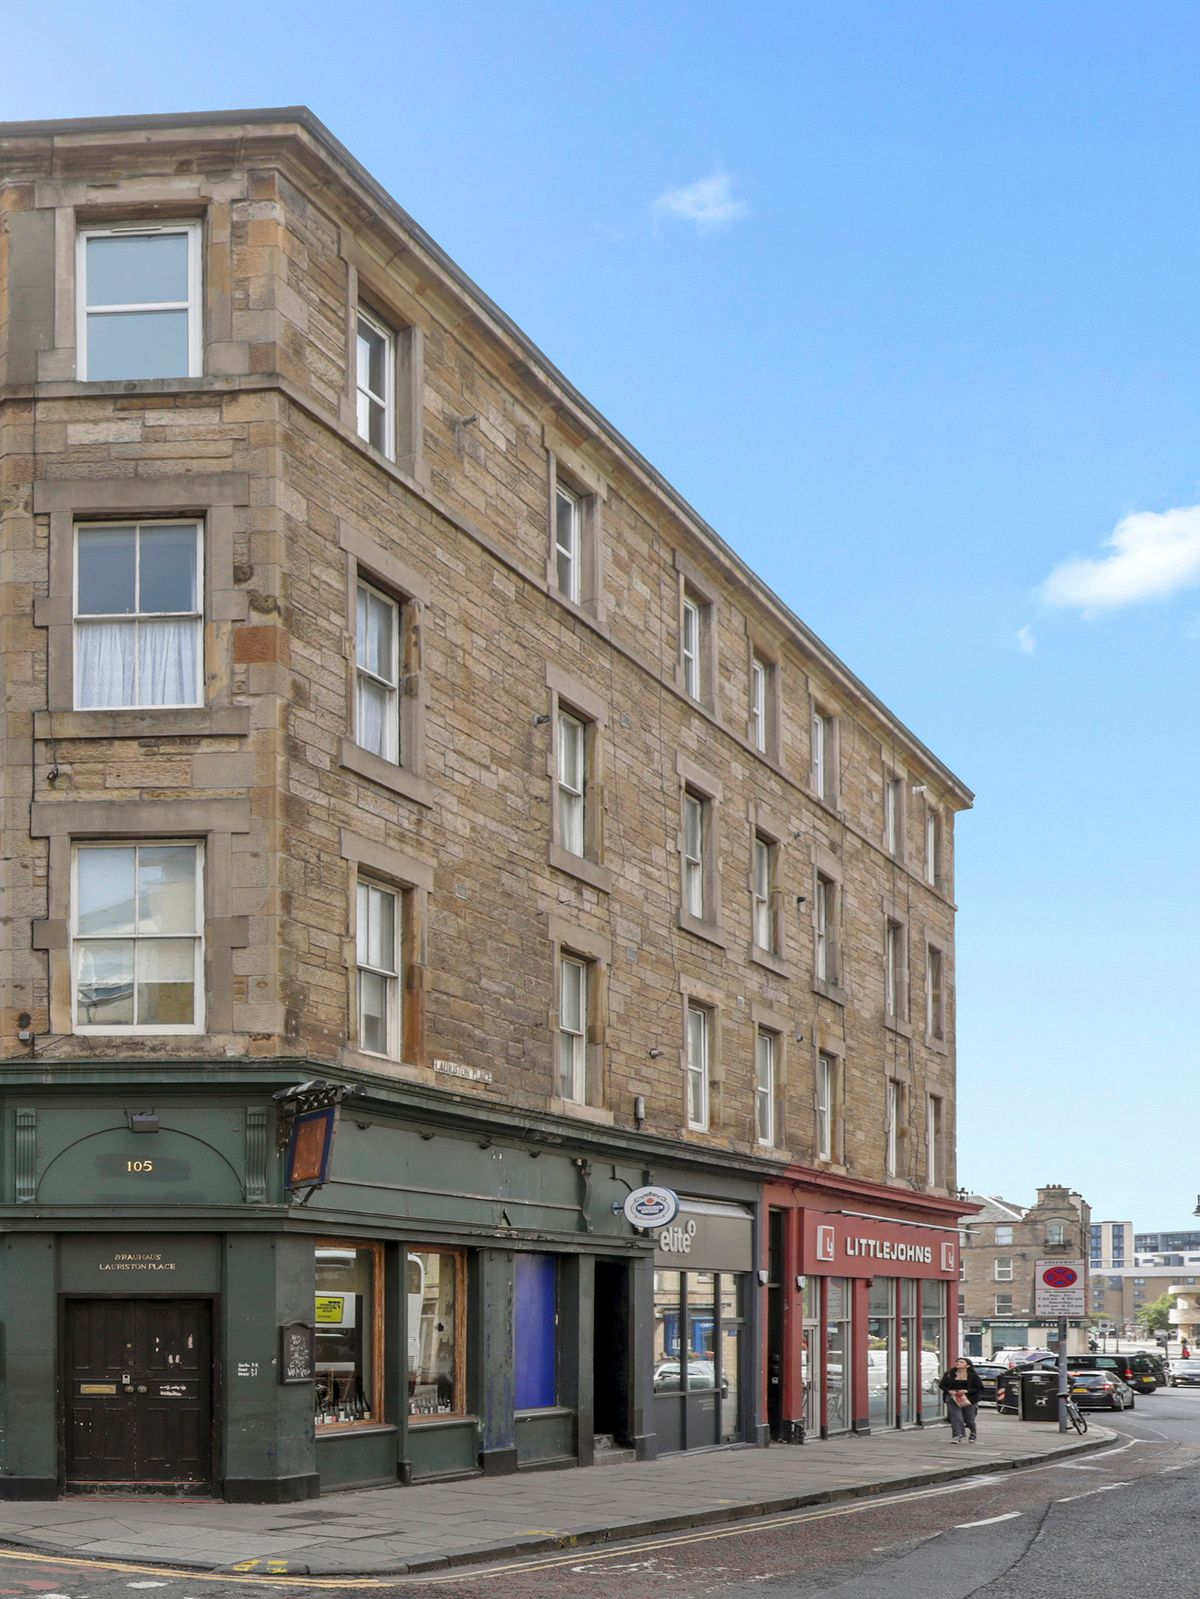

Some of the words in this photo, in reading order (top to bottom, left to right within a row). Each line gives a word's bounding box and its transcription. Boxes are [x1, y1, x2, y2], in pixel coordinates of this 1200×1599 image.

[127, 1160, 153, 1172] 105
[660, 1226, 691, 1253] elite
[846, 1236, 932, 1264] LITTLEJOHNS
